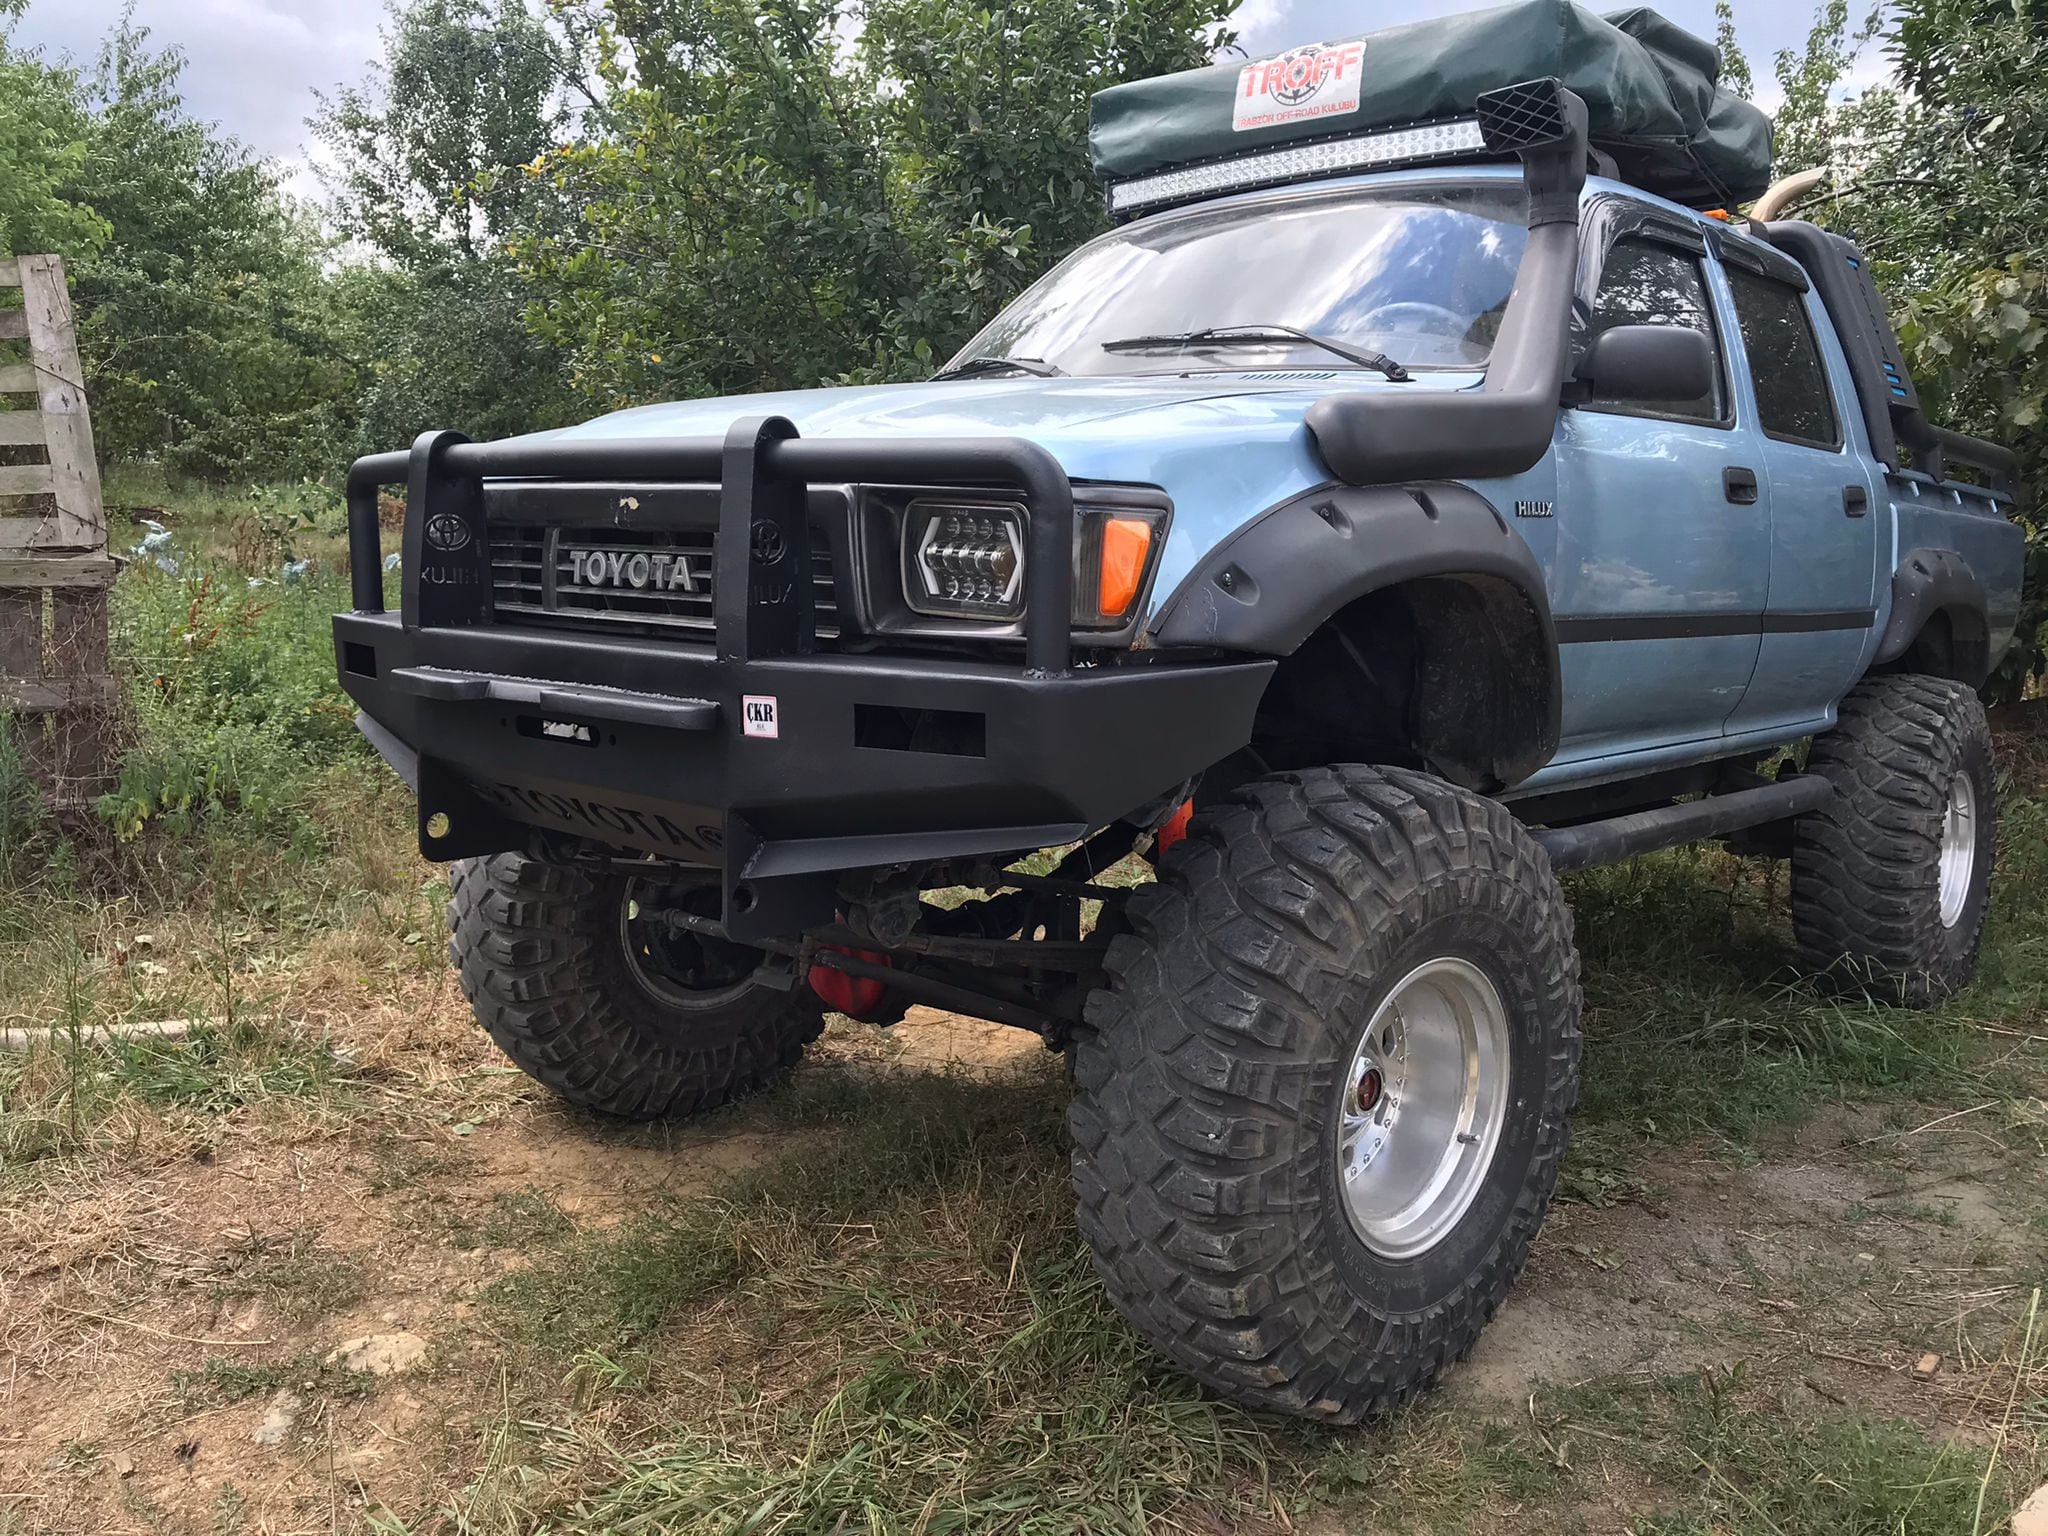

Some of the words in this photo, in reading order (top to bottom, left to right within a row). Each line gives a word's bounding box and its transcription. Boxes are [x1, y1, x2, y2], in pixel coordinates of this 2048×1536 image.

[1244, 46, 1361, 97] TROFF
[1516, 501, 1553, 517] HILUX
[570, 551, 695, 591] TOYOTA
[747, 703, 773, 724] ÇKR
[496, 783, 707, 850] TOYOTA
